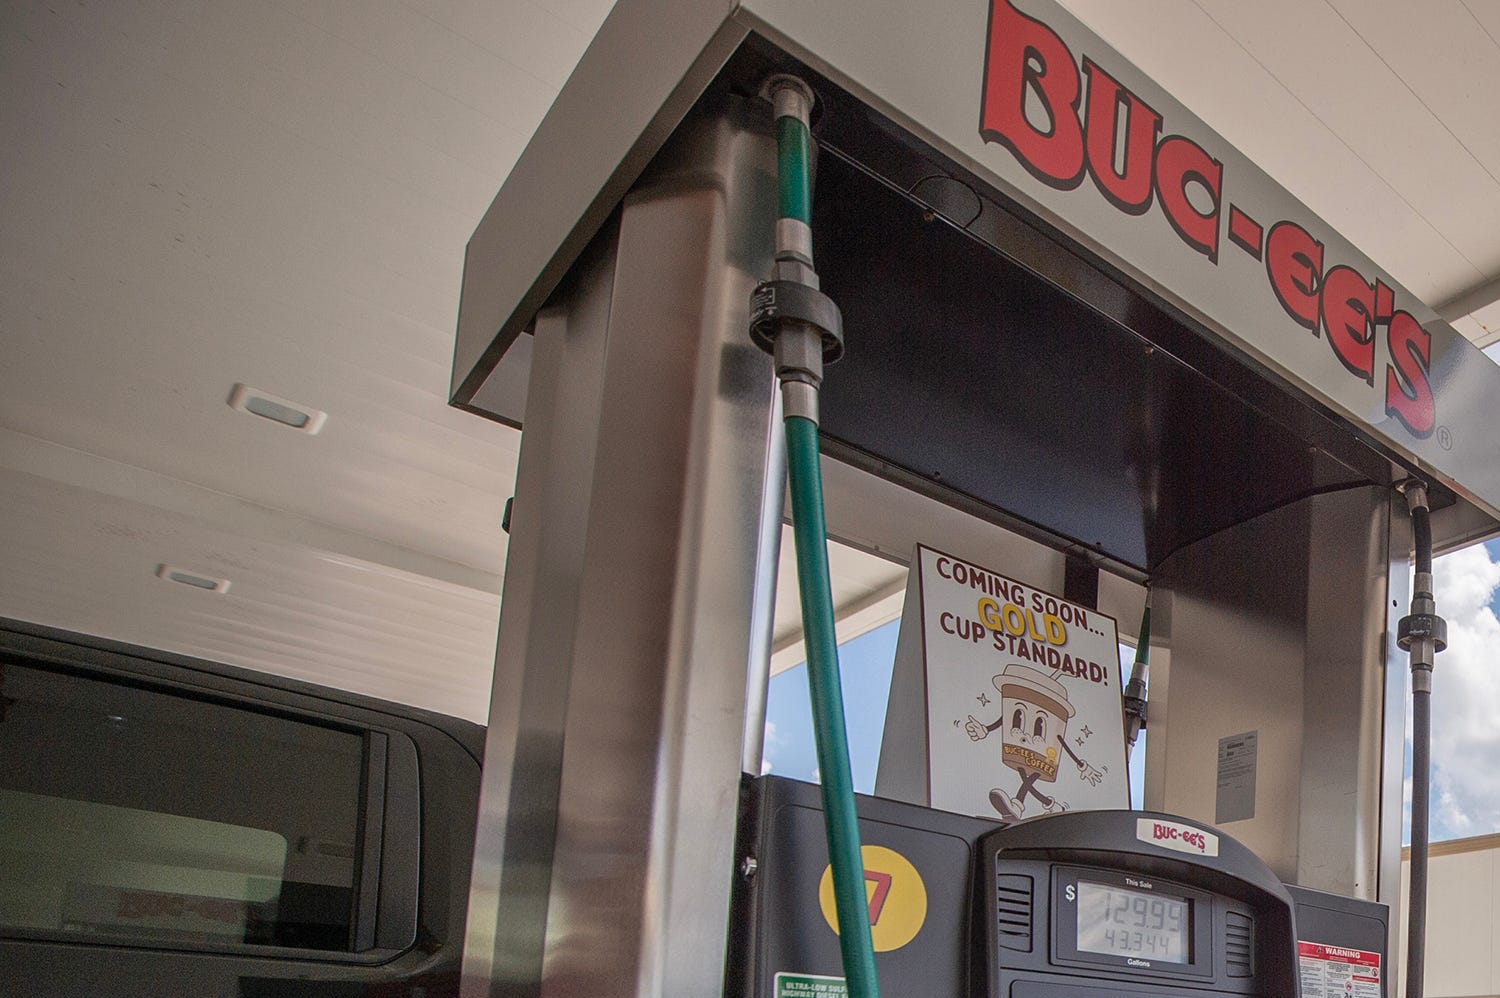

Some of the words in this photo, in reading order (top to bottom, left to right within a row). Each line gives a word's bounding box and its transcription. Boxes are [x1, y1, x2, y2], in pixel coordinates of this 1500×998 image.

[979, 0, 1436, 440] BUC-EE'S
[936, 557, 1025, 608] COMING
[1032, 592, 1104, 637] SOON...
[977, 597, 1068, 647] GOLD
[940, 611, 985, 644] CUP
[993, 631, 1109, 686] STANDARD!
[1025, 757, 1055, 776] COFFEE
[1153, 823, 1206, 850] BUC-EE'S
[1125, 878, 1138, 886] This
[1139, 880, 1153, 889] Sale
[1065, 884, 1076, 903] $
[1325, 947, 1361, 959] WARNING
[1127, 958, 1151, 968] Gallons
[781, 990, 815, 998] HIGHWAY
[785, 982, 827, 992] ULTRA-LOW
[828, 985, 847, 993] SULF
